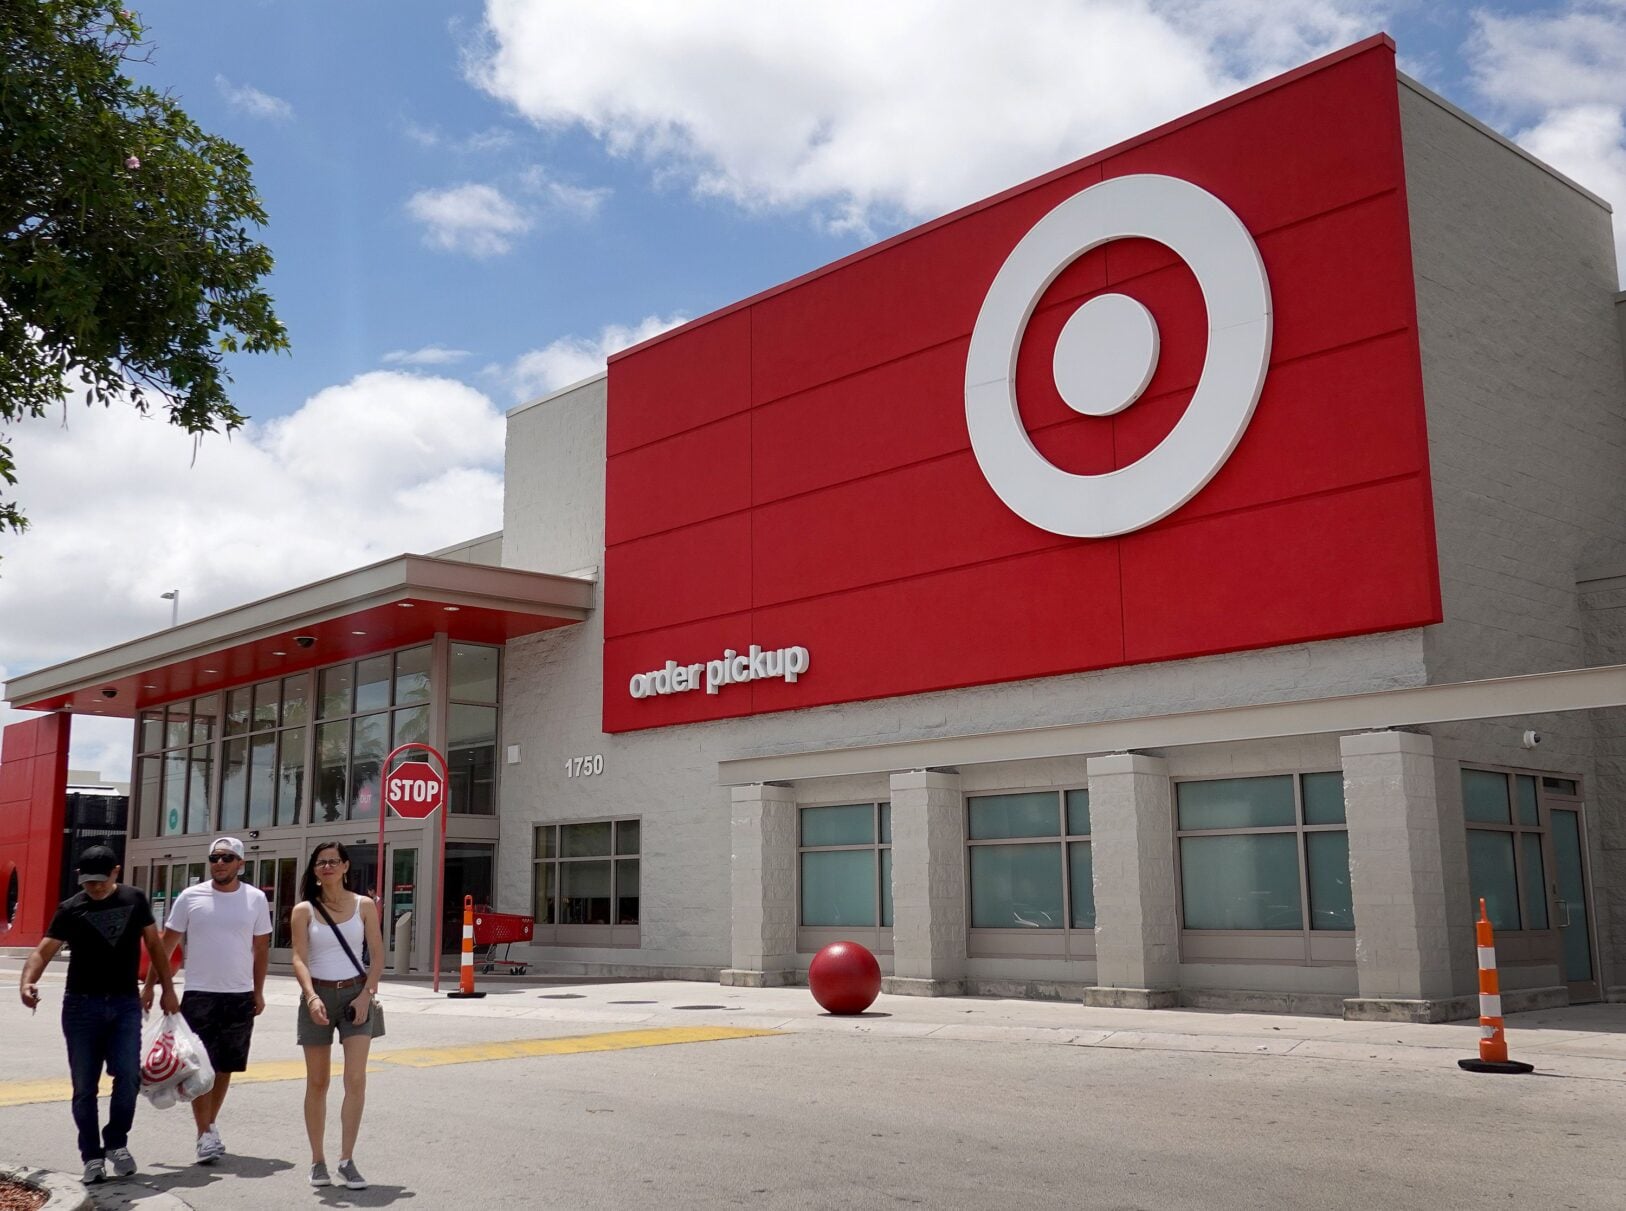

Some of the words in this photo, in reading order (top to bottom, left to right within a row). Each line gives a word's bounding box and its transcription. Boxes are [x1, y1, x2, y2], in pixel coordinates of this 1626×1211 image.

[629, 660, 705, 698] order
[706, 644, 810, 695] pickup
[564, 754, 604, 778] 1750
[390, 778, 439, 802] STOP
